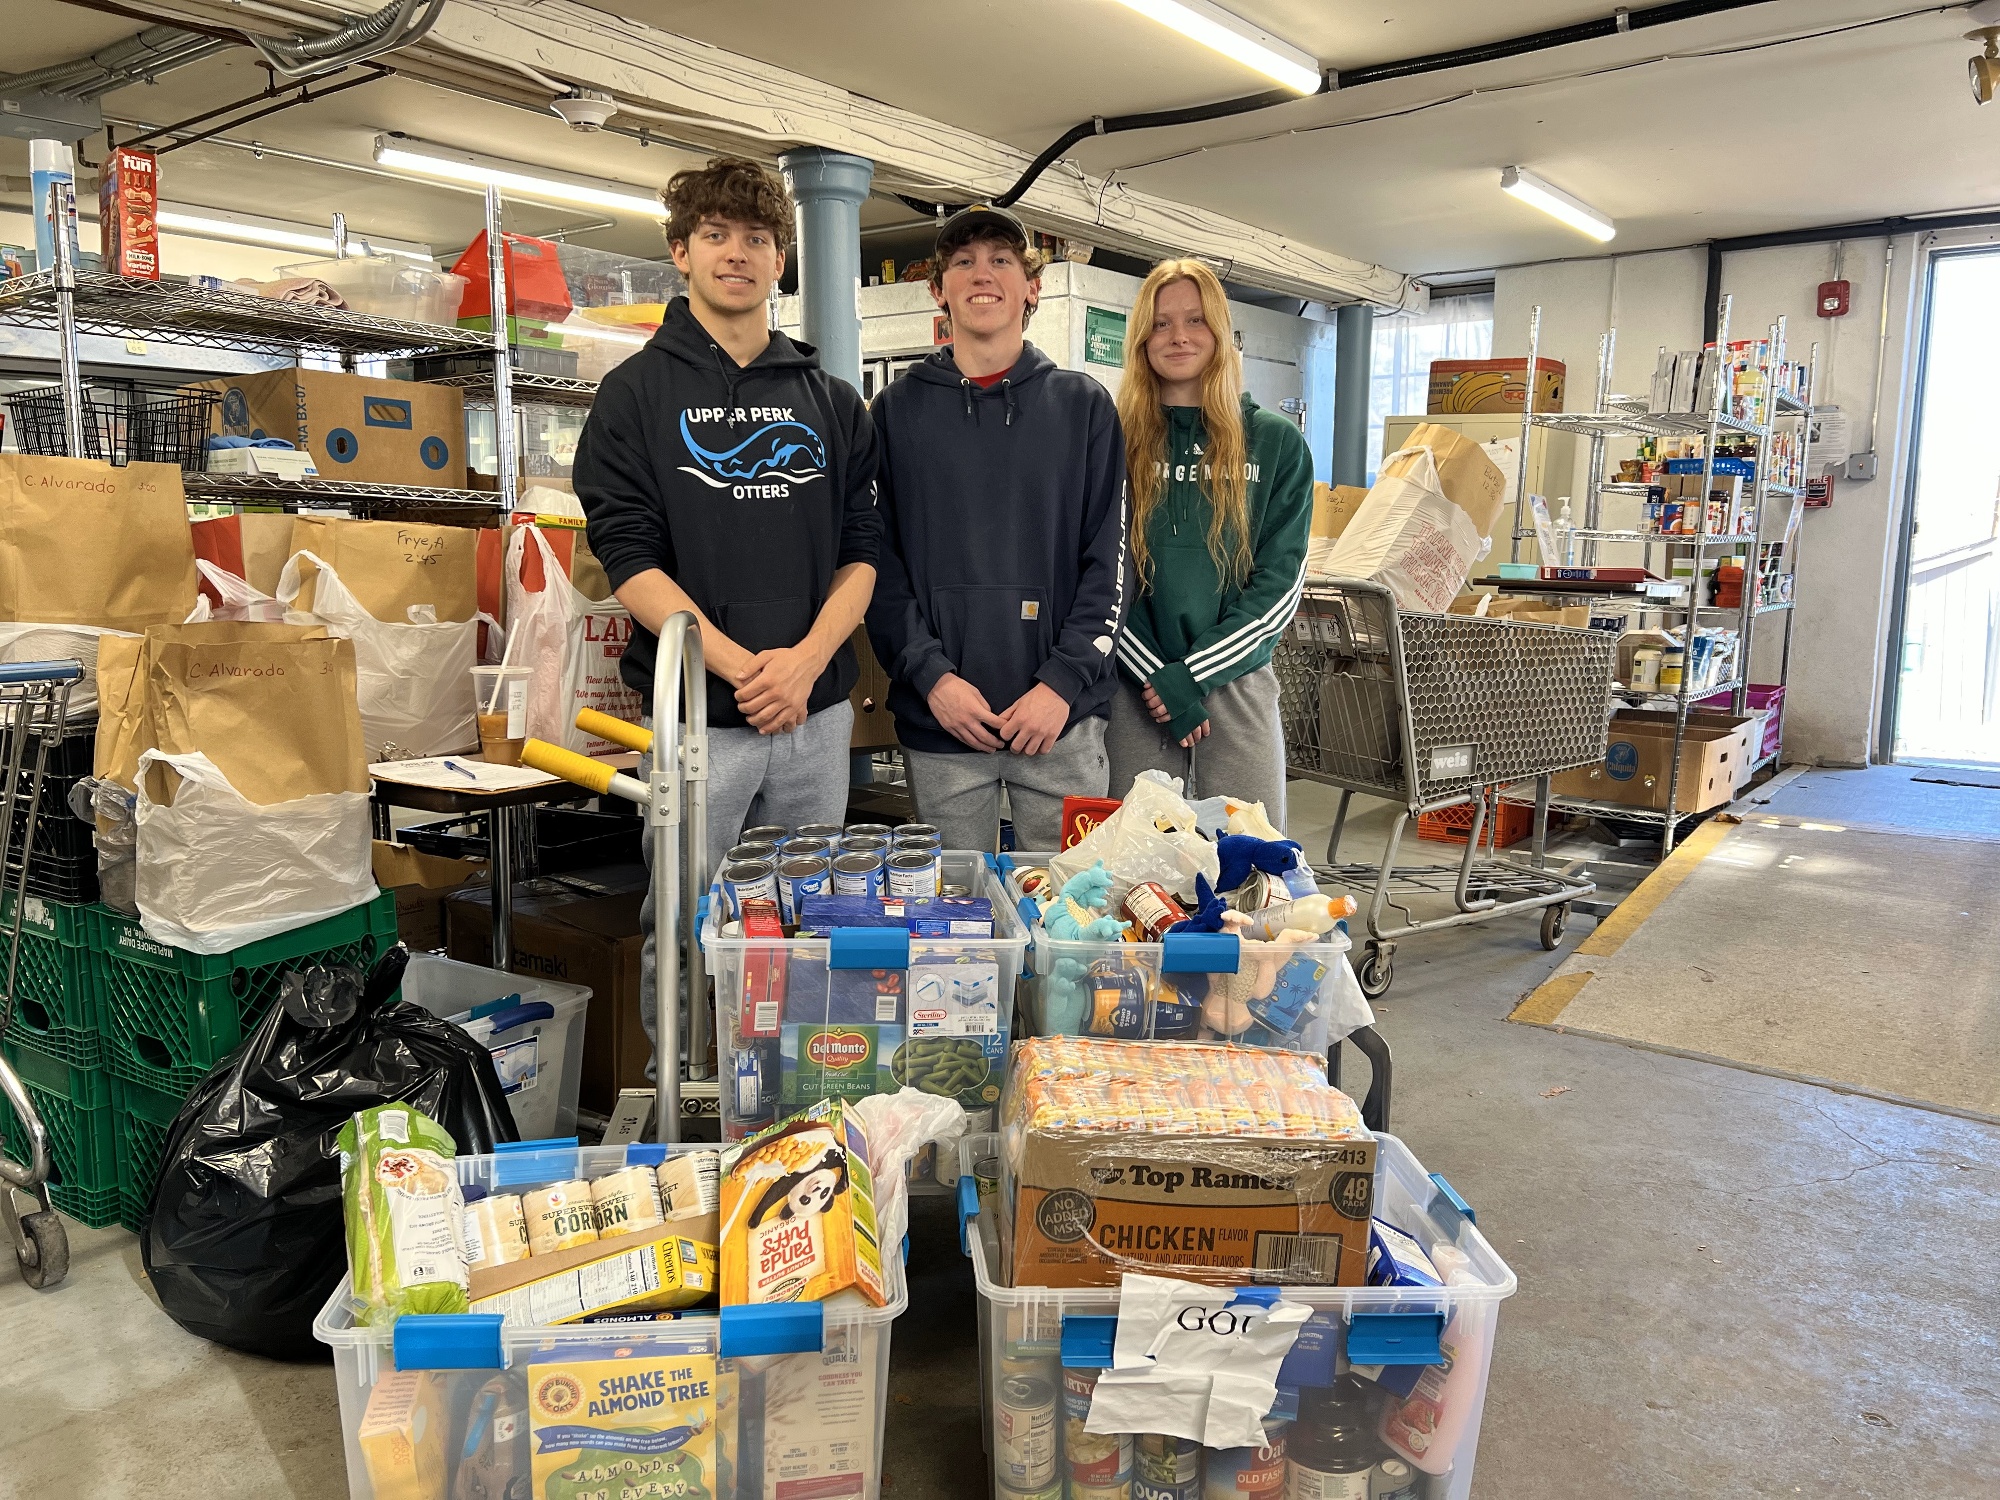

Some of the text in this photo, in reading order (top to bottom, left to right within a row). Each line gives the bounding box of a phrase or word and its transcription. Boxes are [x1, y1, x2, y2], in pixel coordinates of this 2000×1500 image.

[123, 155, 152, 173] fun
[128, 253, 153, 262] MILK-BONE
[750, 407, 796, 422] PERK
[40, 475, 116, 494] Alvarado
[733, 484, 790, 499] OTTERS
[558, 517, 584, 527] FAMILY
[1418, 520, 1459, 563] THANK
[1409, 535, 1447, 578] THANK
[1399, 550, 1451, 609] THANK YOU
[209, 663, 285, 678] Alvarado
[1433, 752, 1468, 770] weis
[1606, 760, 1636, 773] Chiquita
[917, 1012, 943, 1020] Sterilite
[987, 1033, 1002, 1046] 12
[812, 1042, 866, 1054] Del Monte
[827, 1055, 849, 1063] Quality
[803, 1083, 871, 1091] CUT GREEN BEANS
[1129, 1165, 1184, 1193] Top
[1343, 1177, 1368, 1201] 48
[1054, 1197, 1075, 1211] NO
[1342, 1200, 1365, 1208] PACK
[541, 1208, 577, 1221] SUPER
[1044, 1208, 1091, 1226] ADDED
[759, 1216, 796, 1239] ORGANIC
[1053, 1223, 1083, 1236] MSG
[759, 1219, 810, 1256] Puffs
[1100, 1225, 1248, 1252] CHICKEN FLAVOR
[760, 1236, 814, 1273] Panda
[1154, 1253, 1170, 1265] AND
[1172, 1253, 1209, 1266] ARTIFICIAL
[1212, 1255, 1245, 1267] FLAVORS
[662, 1241, 677, 1284] Cheerios
[762, 1257, 811, 1286] PEANUT BUTTER
[593, 1313, 652, 1324] ALMONDS
[822, 1354, 858, 1366] QUAKER
[599, 1367, 693, 1397] SHAKE THE
[818, 1373, 850, 1381] GOODNESS
[555, 1379, 578, 1400] BUNCHES
[588, 1381, 710, 1418] ALMOND TREE
[553, 1402, 574, 1413] OATS
[578, 1460, 675, 1482] ALMONDS
[1237, 1472, 1259, 1484] OLD
[623, 1482, 685, 1498] EVERY
